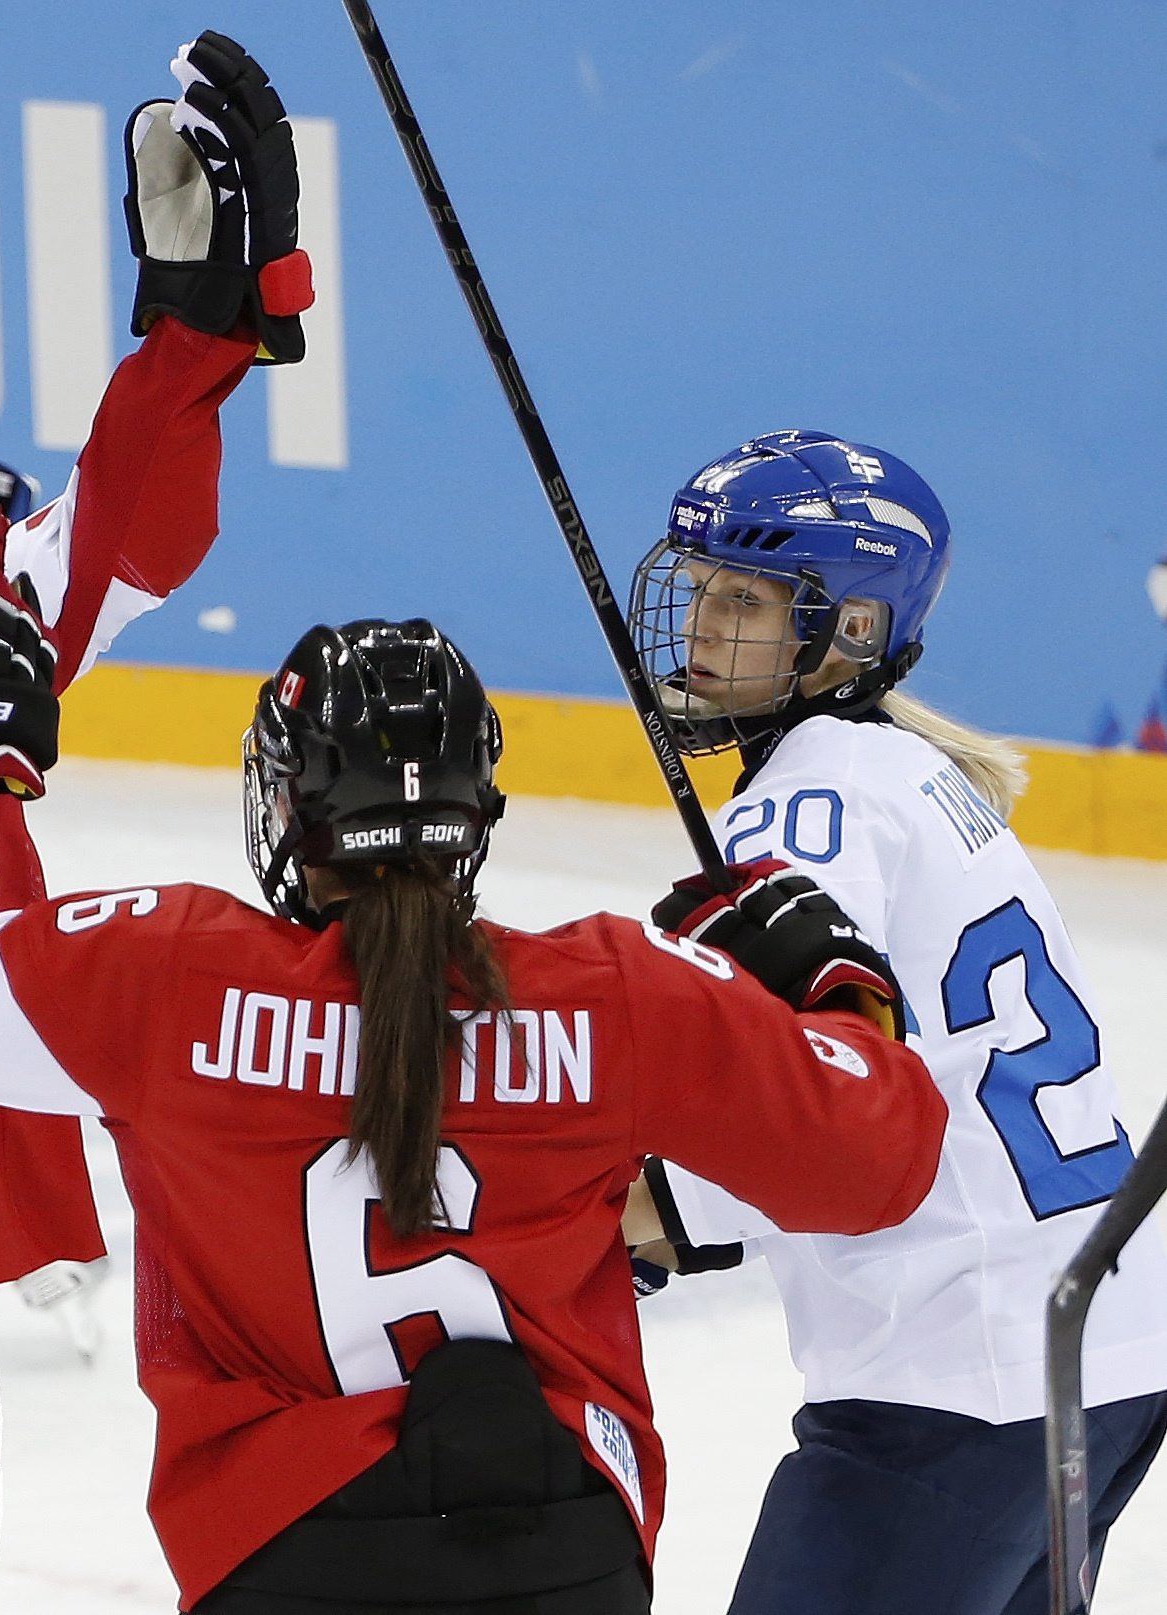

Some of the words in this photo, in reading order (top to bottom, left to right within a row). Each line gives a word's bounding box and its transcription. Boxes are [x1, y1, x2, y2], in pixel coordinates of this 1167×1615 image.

[547, 474, 612, 607] NEXUS
[855, 536, 898, 557] Reebok
[403, 762, 421, 802] 6
[644, 710, 684, 784] JOHNSTON
[342, 826, 402, 850] SOCHI
[421, 824, 465, 844] 2014
[724, 788, 845, 866] 20
[55, 886, 160, 936] 6
[191, 986, 592, 1104] JOHTON
[941, 896, 1136, 1222] 2
[306, 1137, 514, 1398] 6
